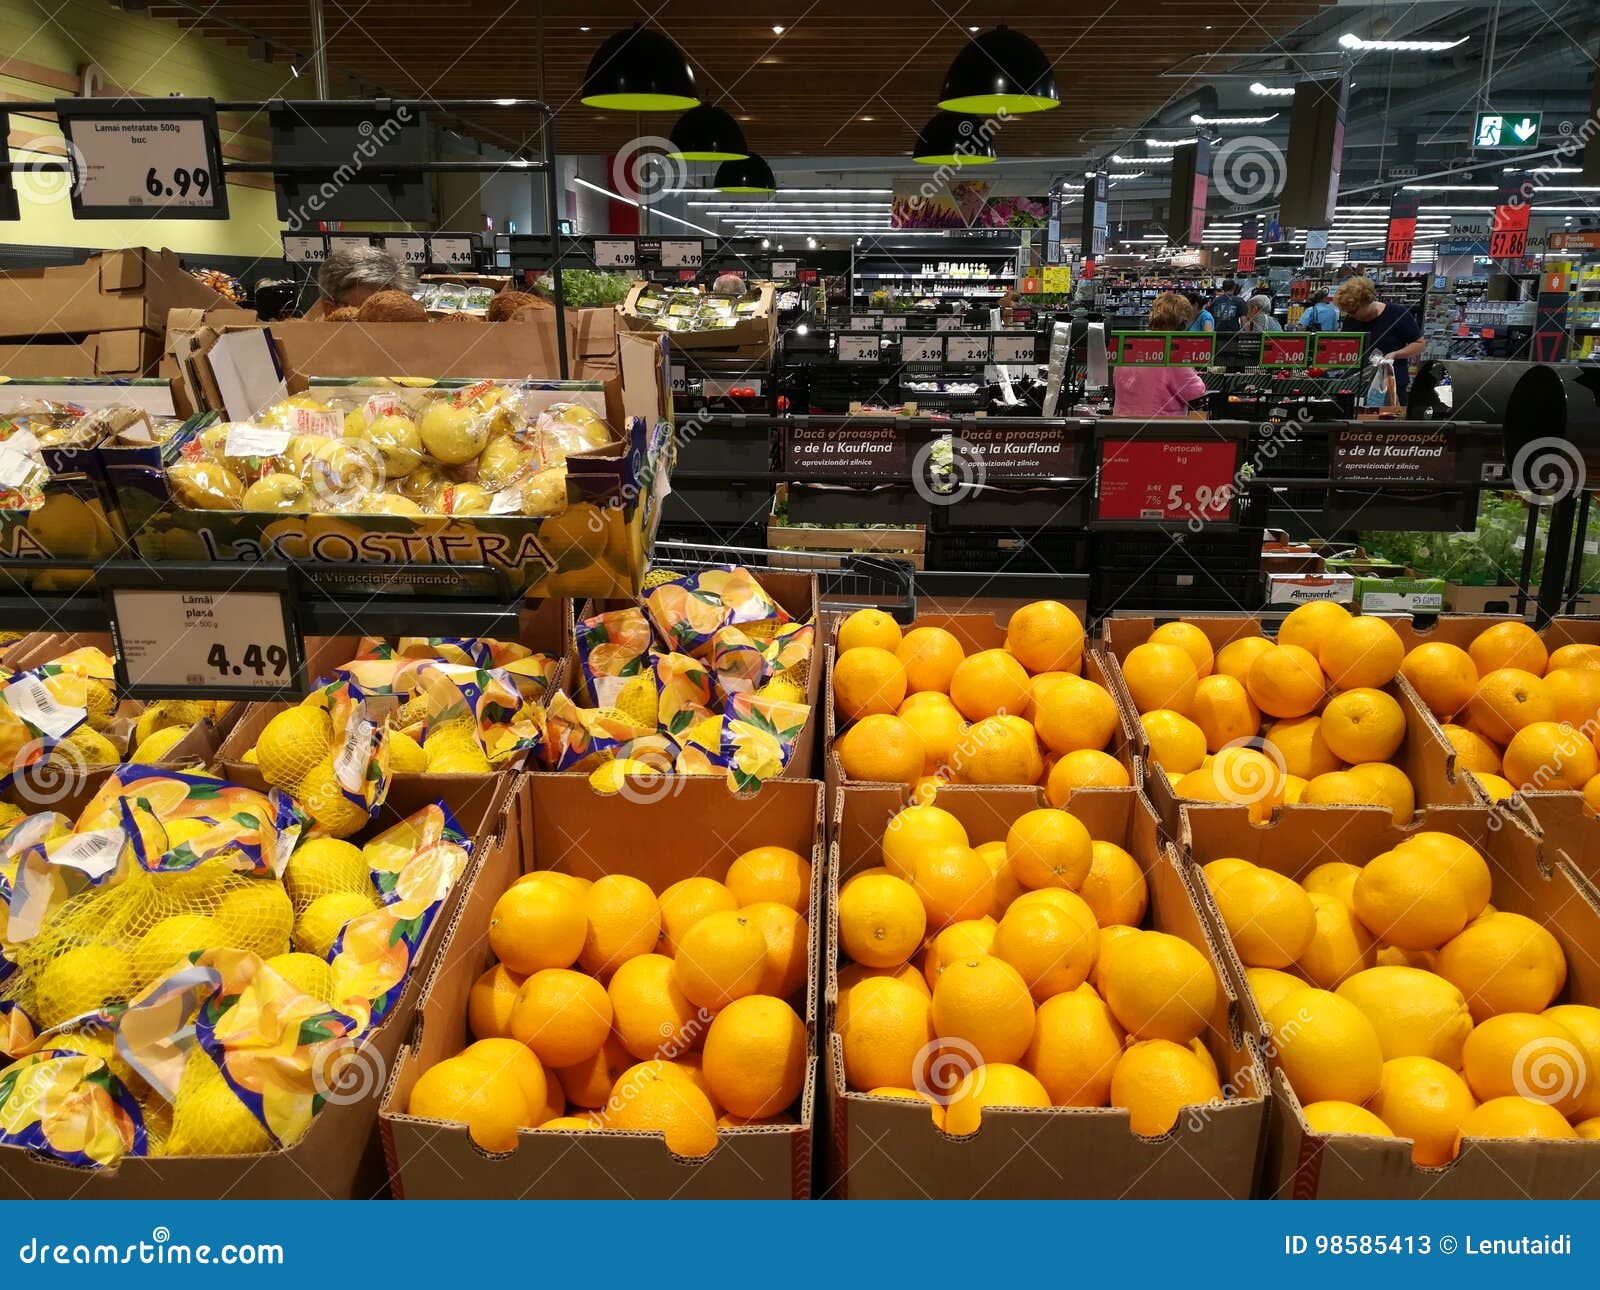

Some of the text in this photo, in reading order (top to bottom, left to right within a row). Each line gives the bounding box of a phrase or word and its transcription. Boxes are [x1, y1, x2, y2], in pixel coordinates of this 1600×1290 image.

[160, 123, 181, 133] 500g
[131, 136, 147, 144] buc
[146, 167, 209, 197] 6.99
[1492, 233, 1523, 255] 57.86
[305, 248, 324, 259] 0.99
[405, 252, 425, 261] 0.99
[451, 252, 471, 261] 4.44
[1388, 242, 1413, 261] 41.89
[615, 254, 635, 264] 4.99
[682, 255, 701, 264] 4.99
[858, 349, 878, 359] 2.49
[921, 350, 942, 359] 3.99
[967, 350, 987, 359] 2.49
[1014, 350, 1033, 359] 1.99
[1145, 351, 1164, 361] 1.00
[1191, 351, 1211, 361] 1.00
[1285, 352, 1304, 361] 1.00
[1338, 352, 1358, 362] 1.00
[794, 428, 825, 439] Dacă
[995, 432, 1003, 440] e
[794, 442, 893, 453] e de la Kaufland
[960, 443, 1060, 454] e de la Kaufland
[1163, 445, 1203, 453] Portocale
[1338, 445, 1443, 457] e de la Kaufland
[1177, 455, 1188, 464] kg
[1167, 484, 1231, 512] 5.99
[199, 529, 559, 571] La COSTIERA
[1290, 590, 1334, 599] Almaverde
[207, 643, 288, 677] 4.49
